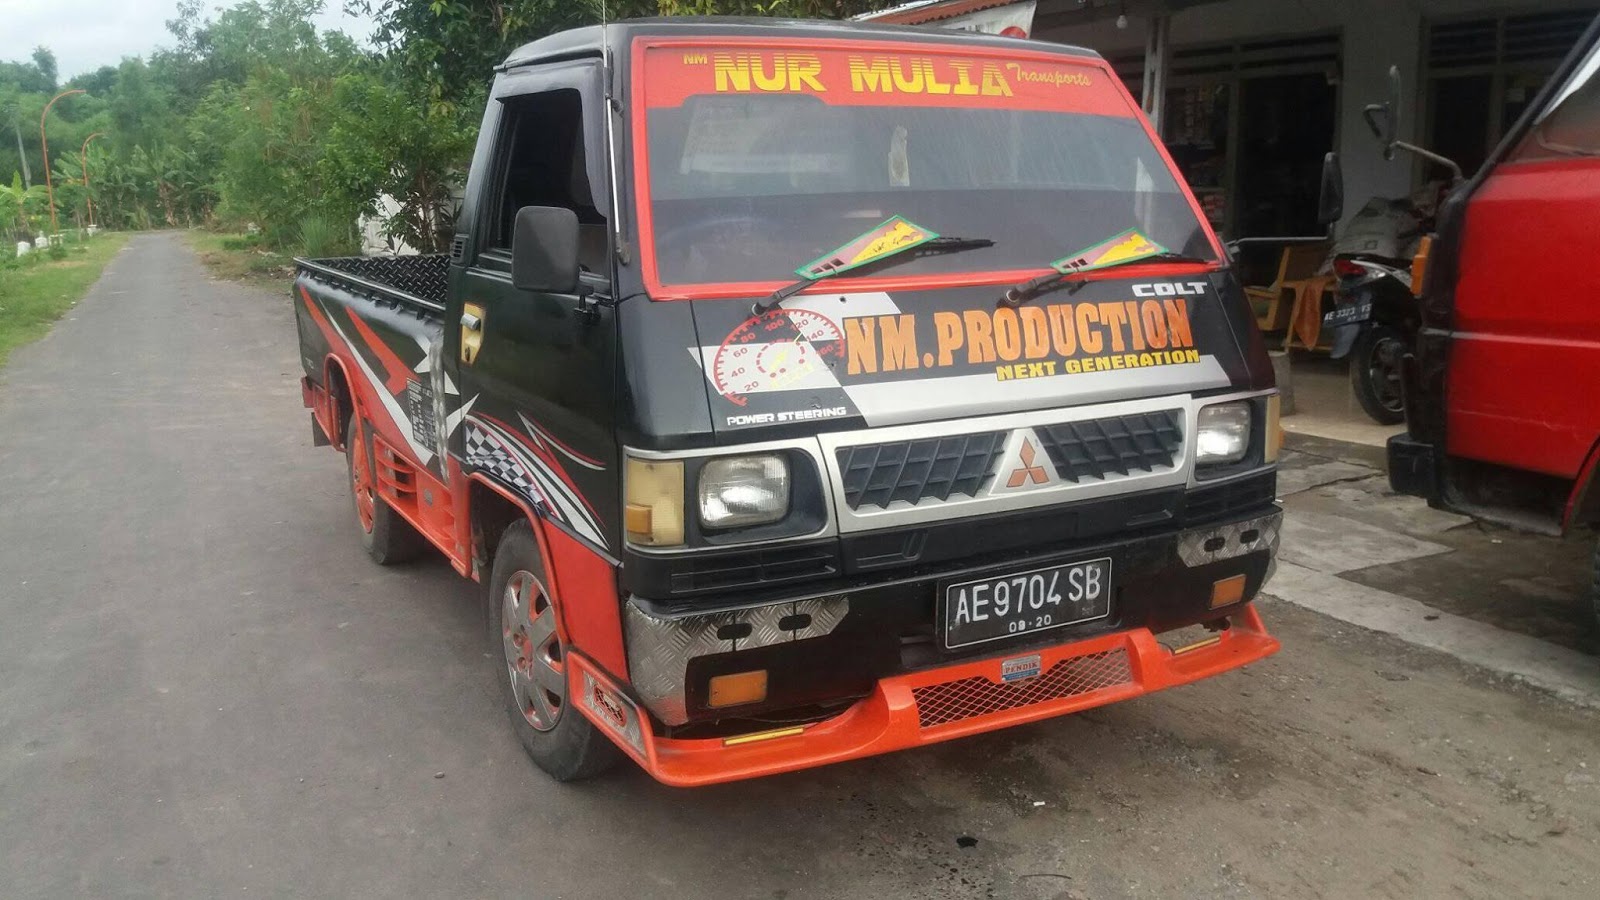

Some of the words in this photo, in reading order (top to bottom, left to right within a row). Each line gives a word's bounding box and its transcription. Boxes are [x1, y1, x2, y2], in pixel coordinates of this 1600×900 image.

[682, 53, 708, 65] NM
[713, 52, 827, 92] NUR
[848, 55, 1014, 97] MULIA
[1006, 62, 1092, 88] Transports
[1132, 281, 1209, 297] COLT
[764, 319, 785, 331] 100
[790, 319, 809, 331] 120
[740, 332, 756, 343] 80
[806, 329, 825, 342] 140
[733, 347, 748, 358] 60
[996, 362, 1057, 382] NEXT
[1065, 349, 1200, 376] GENERATION
[731, 367, 746, 378] 40
[744, 381, 759, 392] 20
[726, 412, 775, 426] POWER
[777, 406, 847, 421] STEERING
[955, 584, 989, 624] AE
[994, 571, 1062, 617] 9704
[1068, 565, 1101, 602] SB
[1005, 661, 1038, 674] PENDIK
